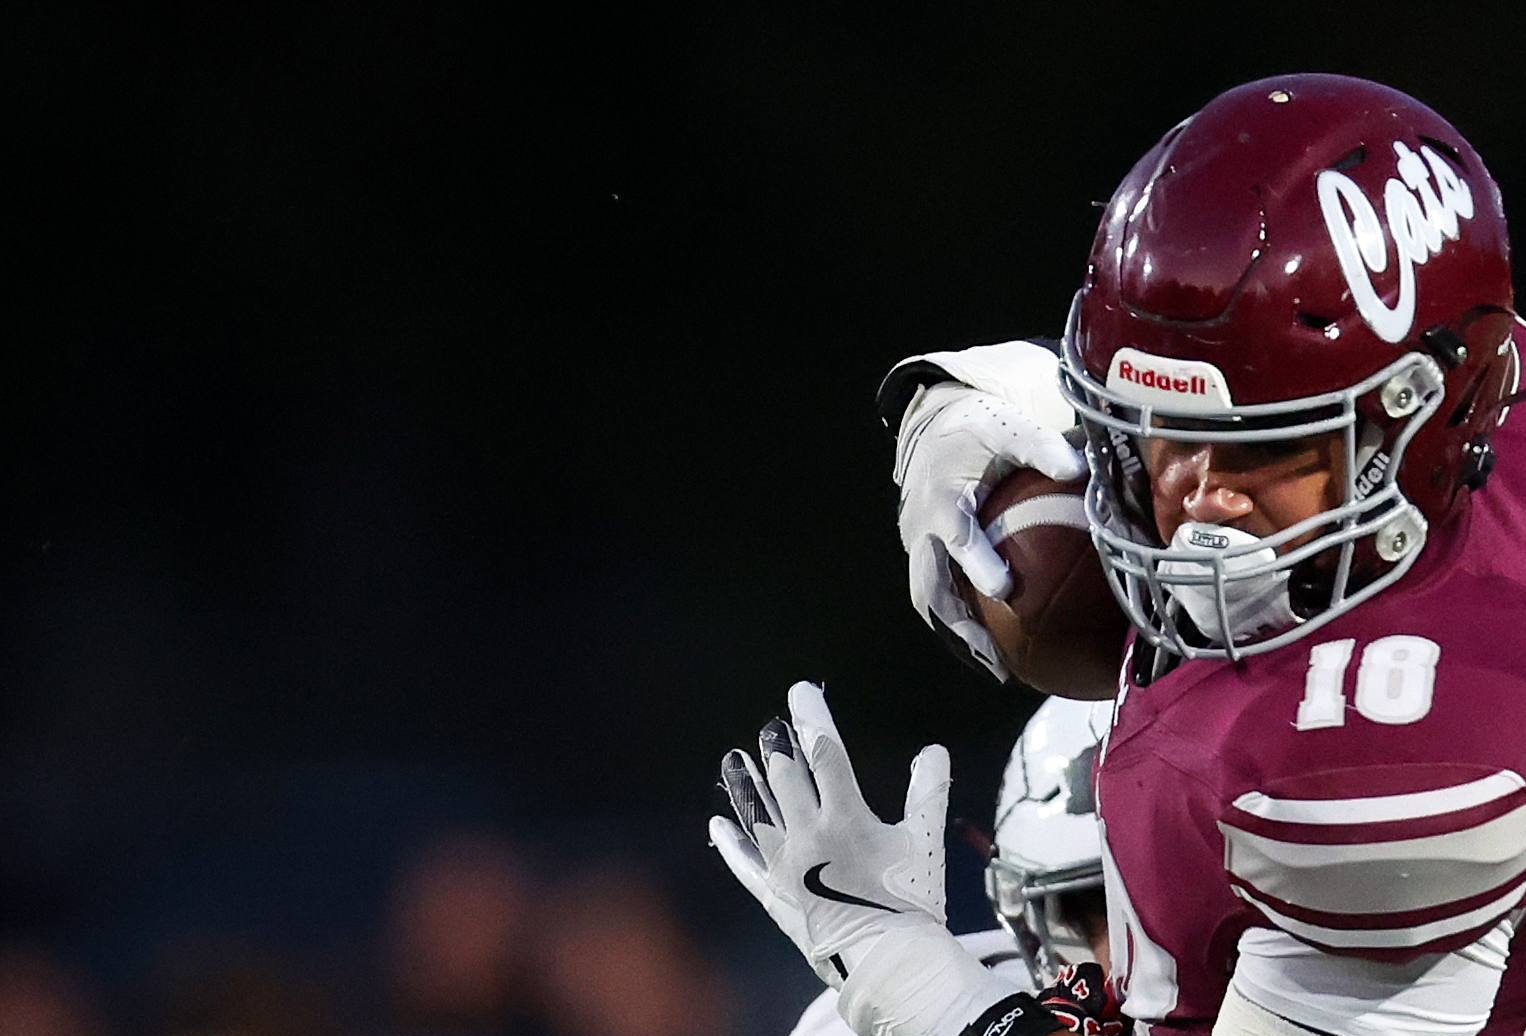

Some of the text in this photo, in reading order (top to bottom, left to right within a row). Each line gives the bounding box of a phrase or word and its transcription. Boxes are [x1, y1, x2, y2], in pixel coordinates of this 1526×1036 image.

[1316, 140, 1474, 343] Cats
[1119, 360, 1206, 395] Riddell
[1297, 635, 1441, 731] 18
